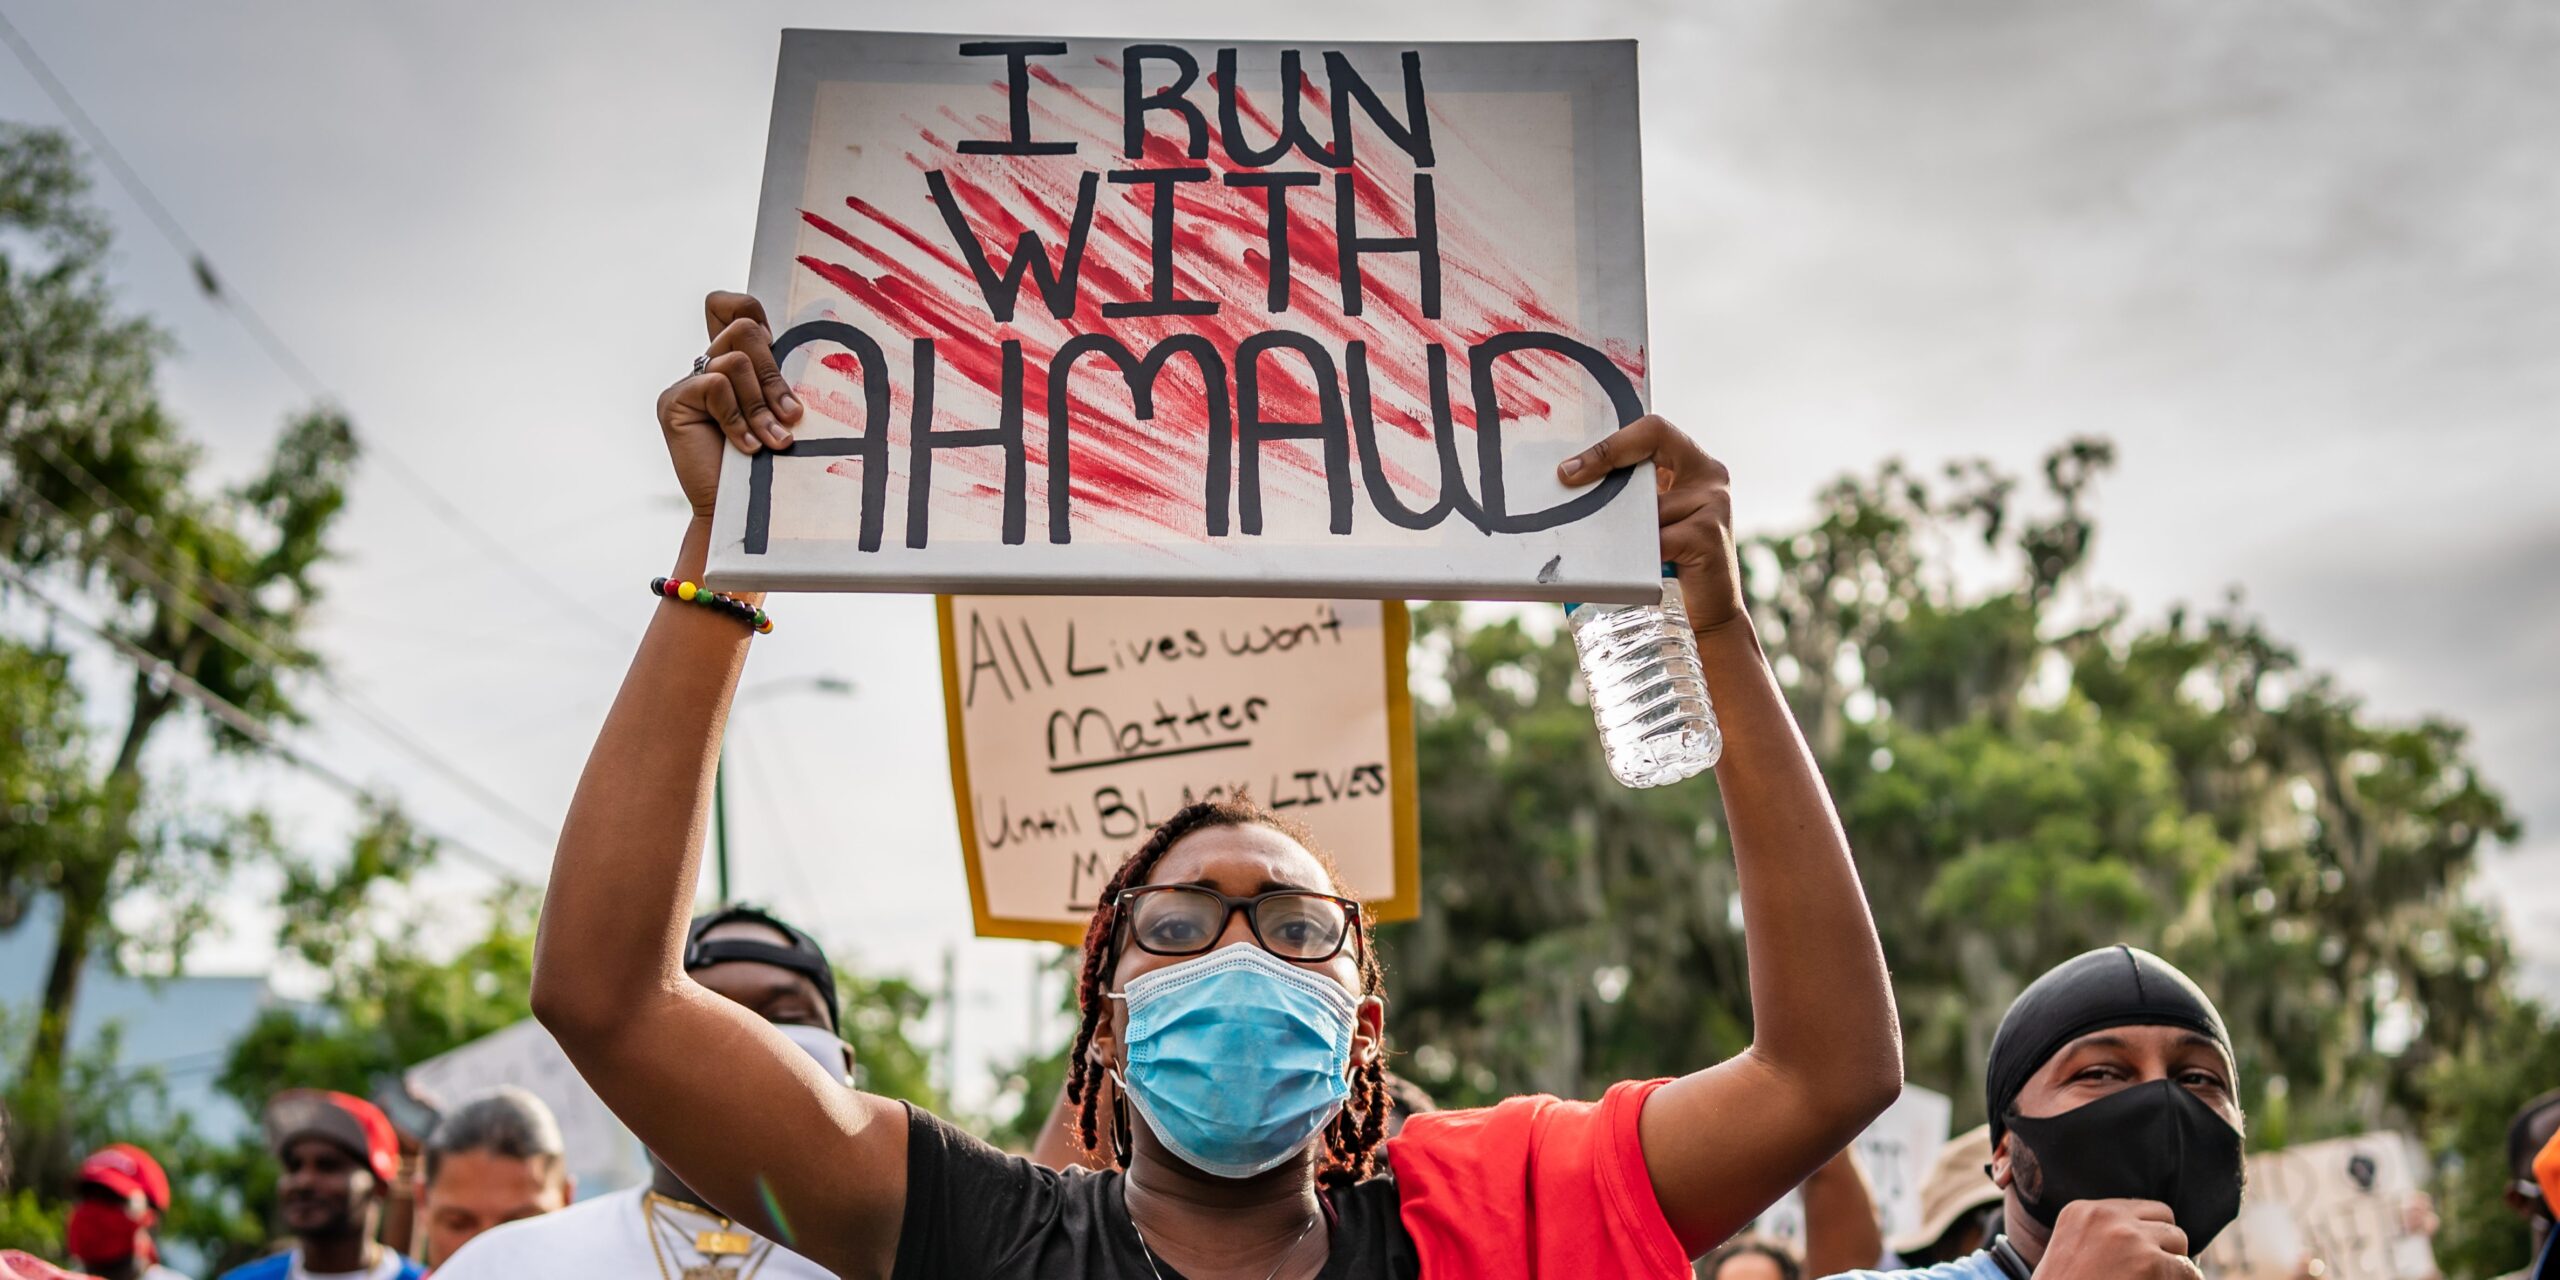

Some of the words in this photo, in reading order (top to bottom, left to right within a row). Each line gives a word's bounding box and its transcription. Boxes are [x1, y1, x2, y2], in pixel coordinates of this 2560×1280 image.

[957, 41, 1078, 156] I
[1122, 44, 1436, 169] RUN
[924, 167, 1442, 323] WITH
[744, 320, 1645, 554] AHMAUD
[966, 607, 1054, 708] All
[1065, 618, 1208, 678] Lives
[1220, 604, 1343, 657] won't
[1047, 696, 1269, 760] Matter
[976, 790, 1080, 849] Until
[1270, 763, 1385, 810] LIVES
